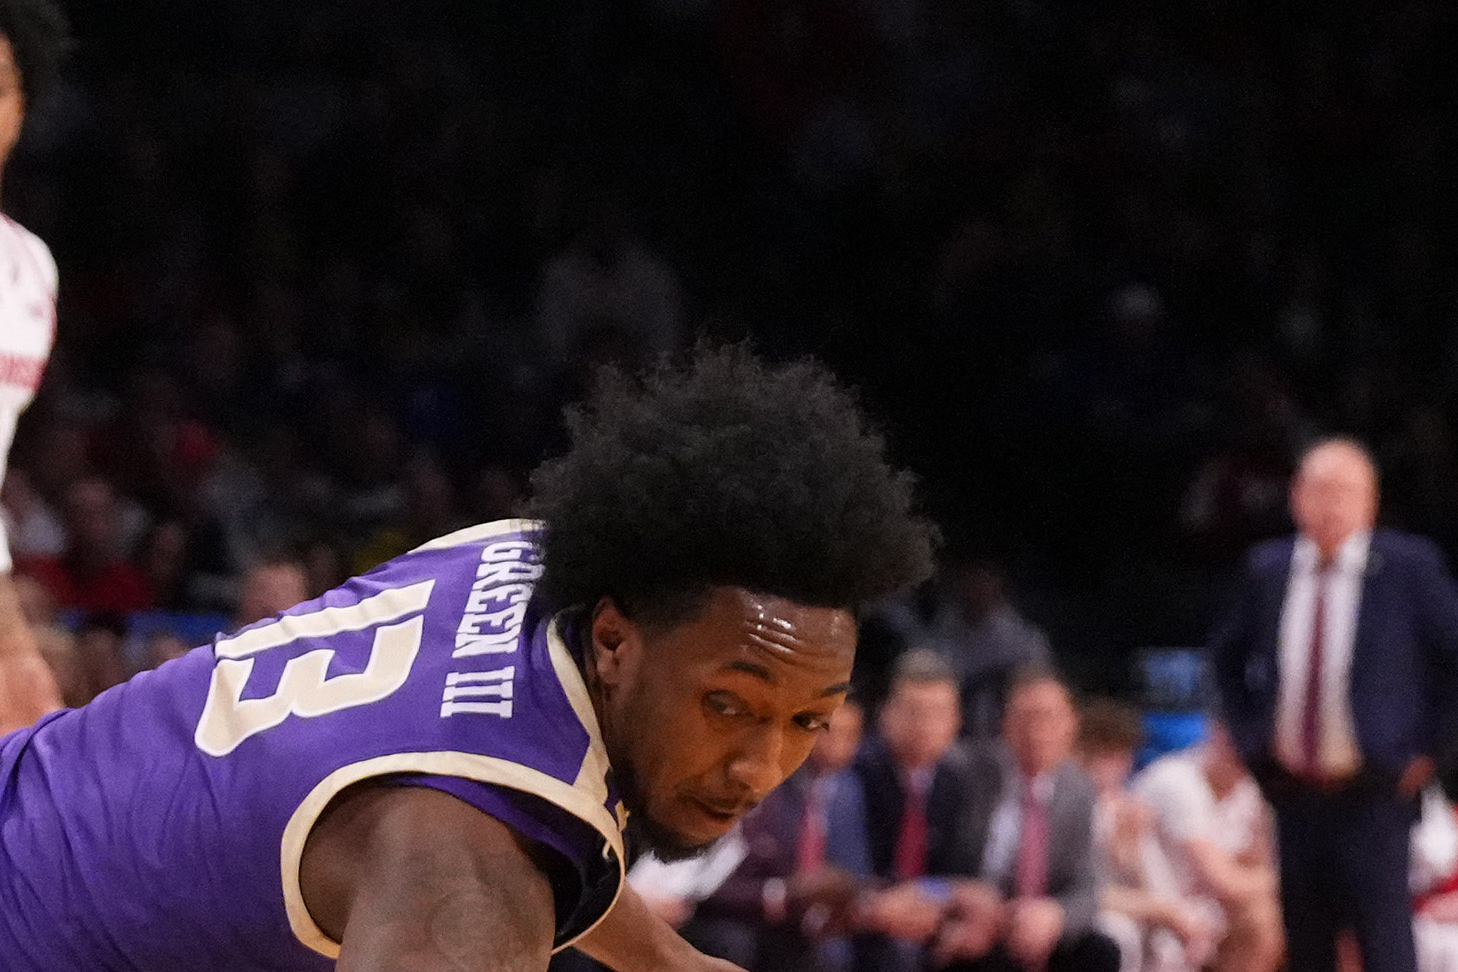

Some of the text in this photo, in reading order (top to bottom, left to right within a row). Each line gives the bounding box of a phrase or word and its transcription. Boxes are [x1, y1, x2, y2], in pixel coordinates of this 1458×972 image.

[194, 578, 436, 758] 13
[440, 540, 545, 718] GREEN III
